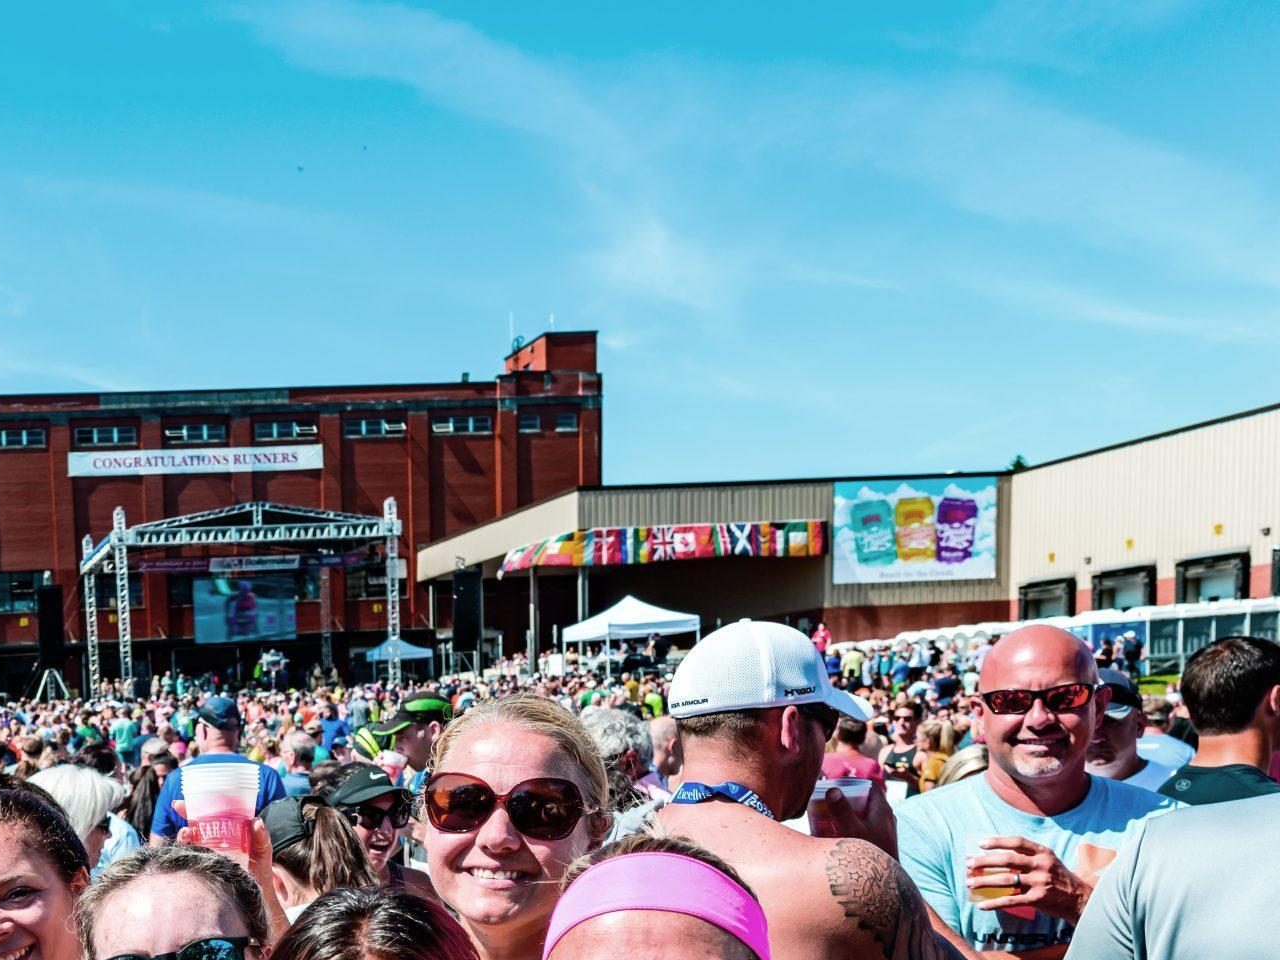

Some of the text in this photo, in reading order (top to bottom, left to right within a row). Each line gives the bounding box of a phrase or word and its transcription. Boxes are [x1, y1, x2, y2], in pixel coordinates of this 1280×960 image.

[93, 452, 299, 470] CONGRATULATIONS RUNNERS
[681, 698, 709, 708] ARMOUR
